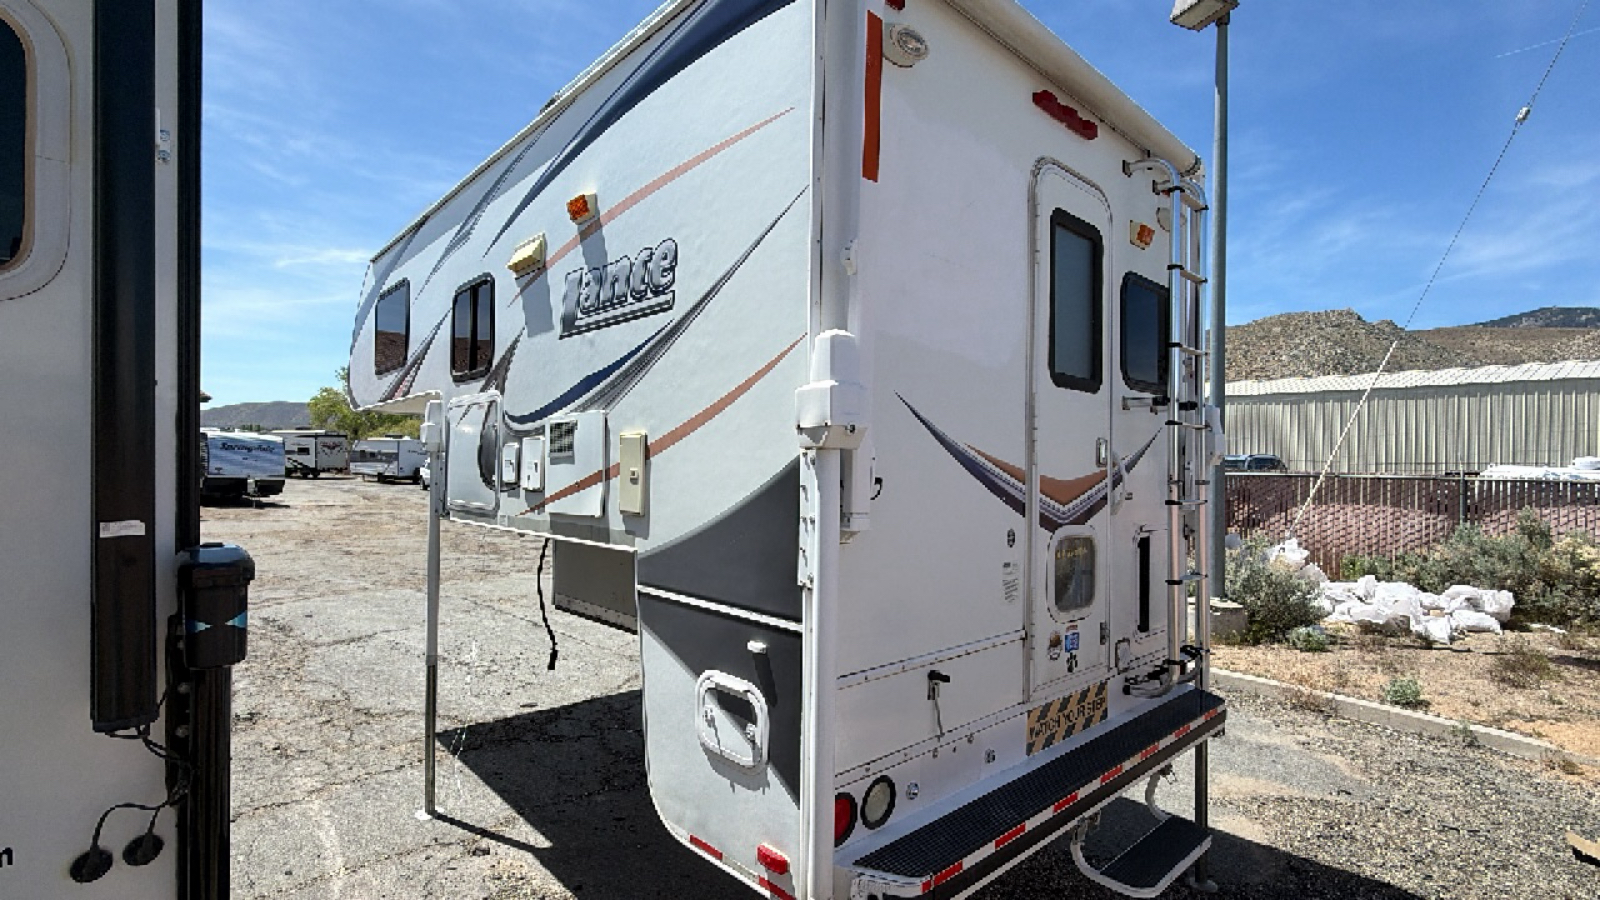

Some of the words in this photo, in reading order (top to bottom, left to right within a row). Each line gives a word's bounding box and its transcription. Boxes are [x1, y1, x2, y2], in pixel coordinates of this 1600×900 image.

[1029, 715, 1060, 740] WATCH
[1062, 703, 1086, 725] YOUR
[1086, 696, 1106, 715] STEP
